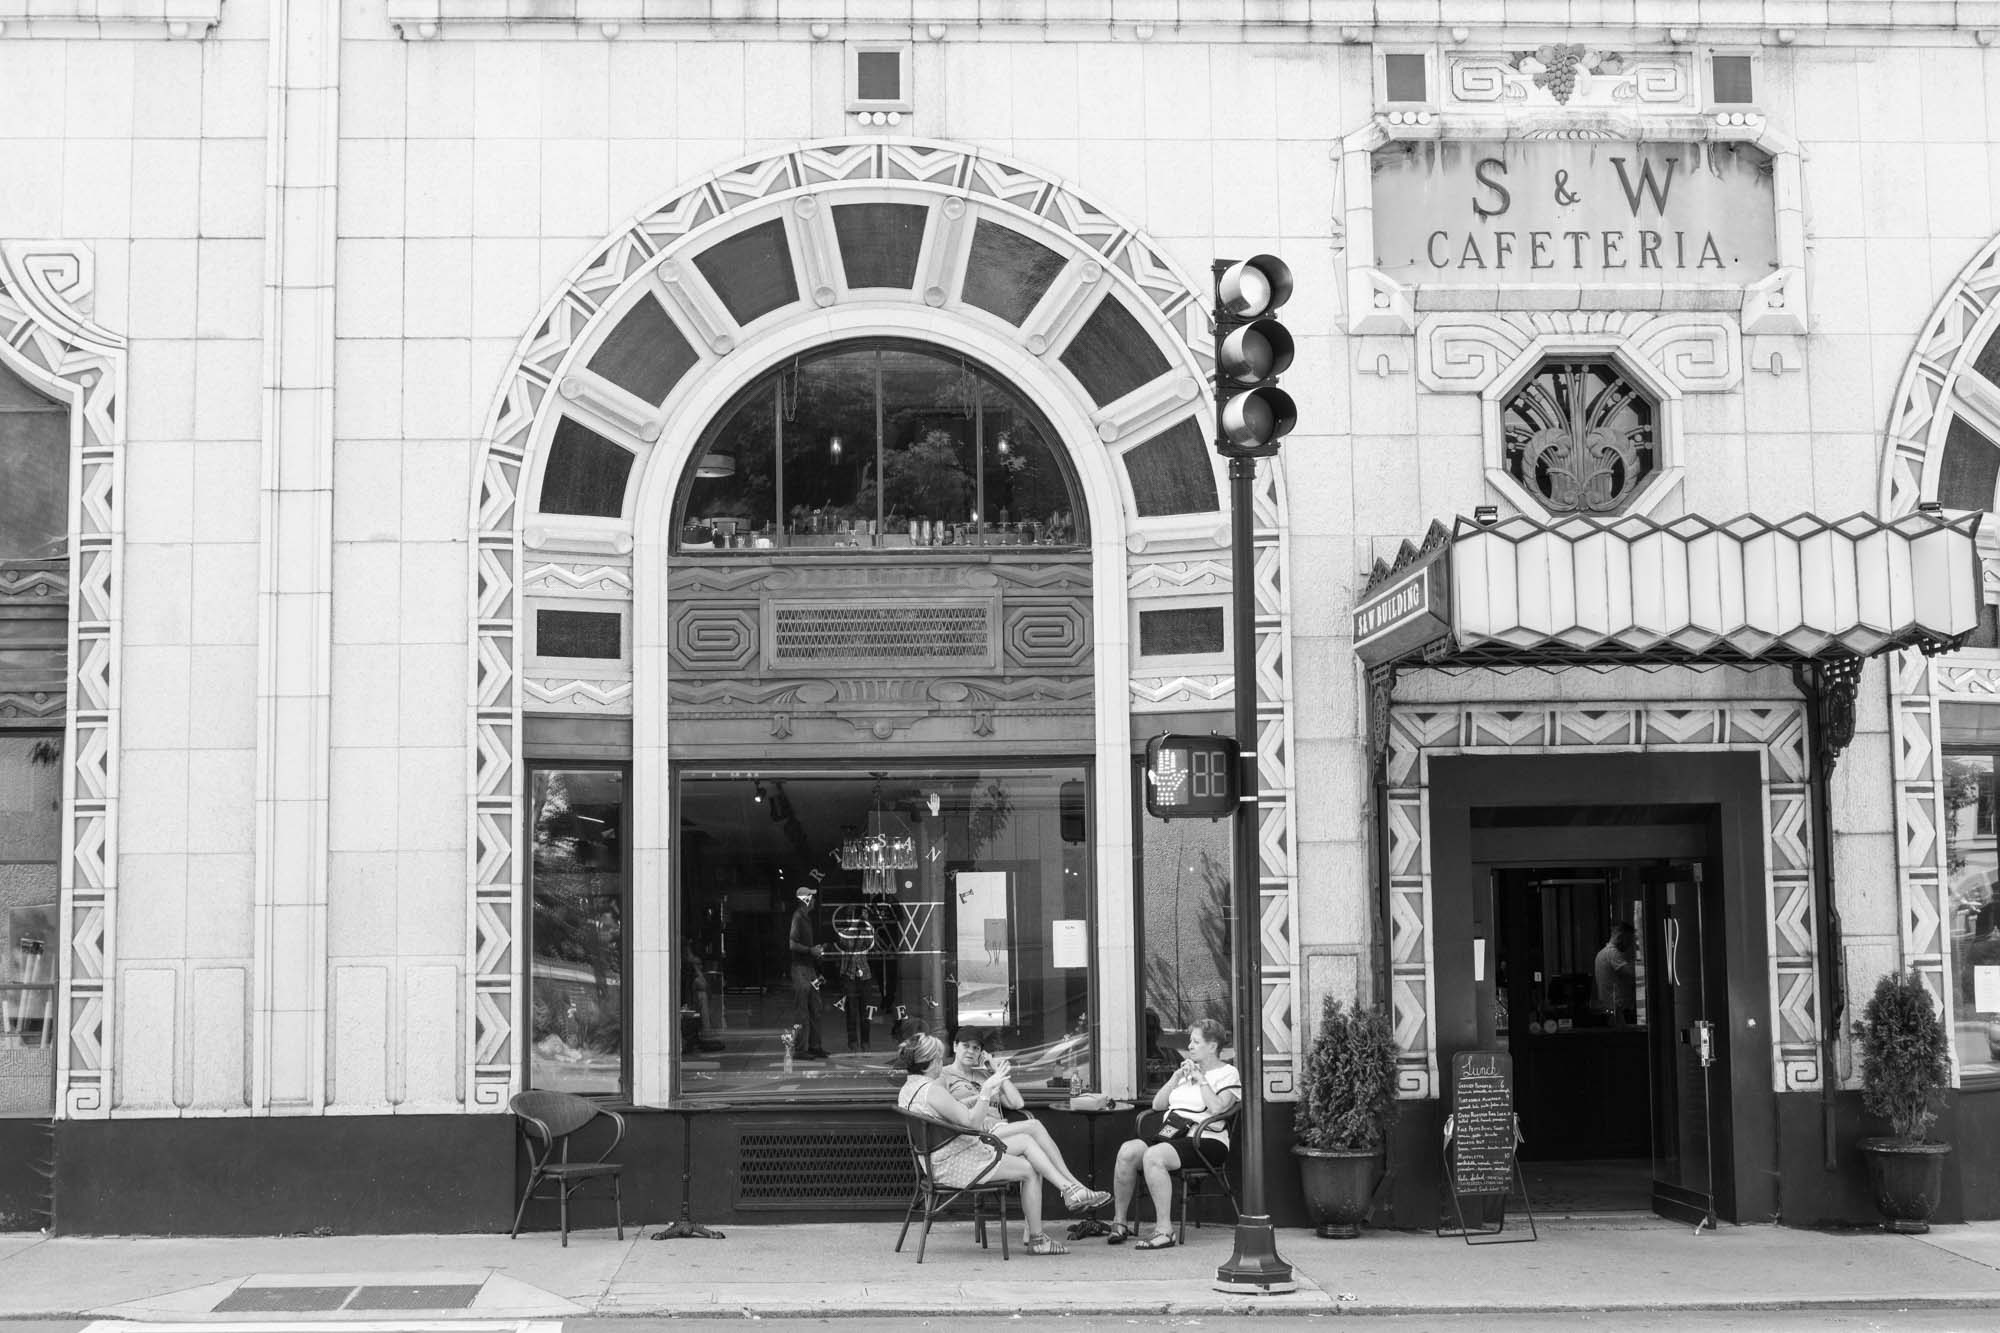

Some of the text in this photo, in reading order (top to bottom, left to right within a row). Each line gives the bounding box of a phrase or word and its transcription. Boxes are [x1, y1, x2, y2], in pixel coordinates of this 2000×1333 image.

[1472, 157, 1679, 217] S & W
[1426, 231, 1726, 269] CAFETERIA
[1376, 583, 1419, 628] BUILDING
[1461, 1055, 1499, 1077] Lunch
